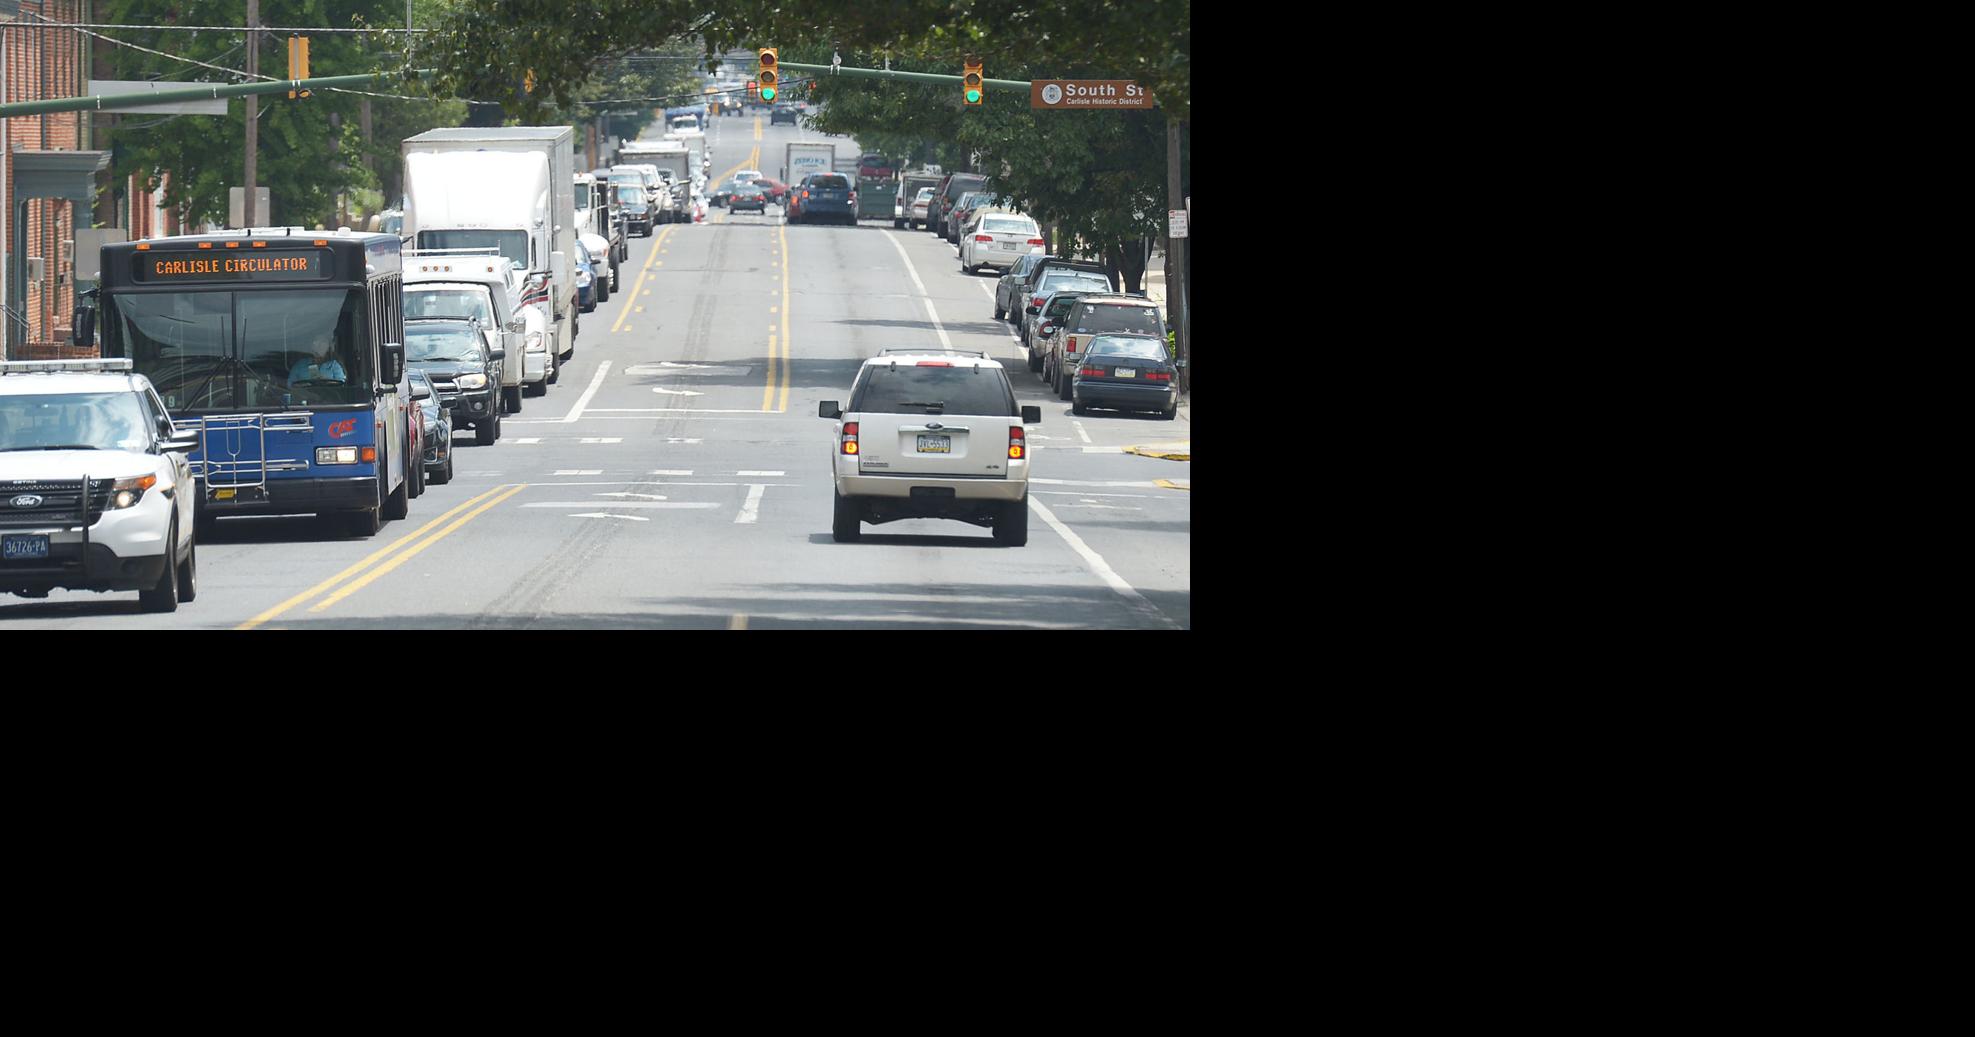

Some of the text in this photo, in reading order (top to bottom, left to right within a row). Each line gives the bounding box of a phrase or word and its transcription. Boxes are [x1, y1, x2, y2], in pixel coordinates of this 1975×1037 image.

[1066, 83, 1144, 97] South St
[156, 257, 307, 274] CARLISLE CIRCULATOR
[16, 497, 36, 506] Ford
